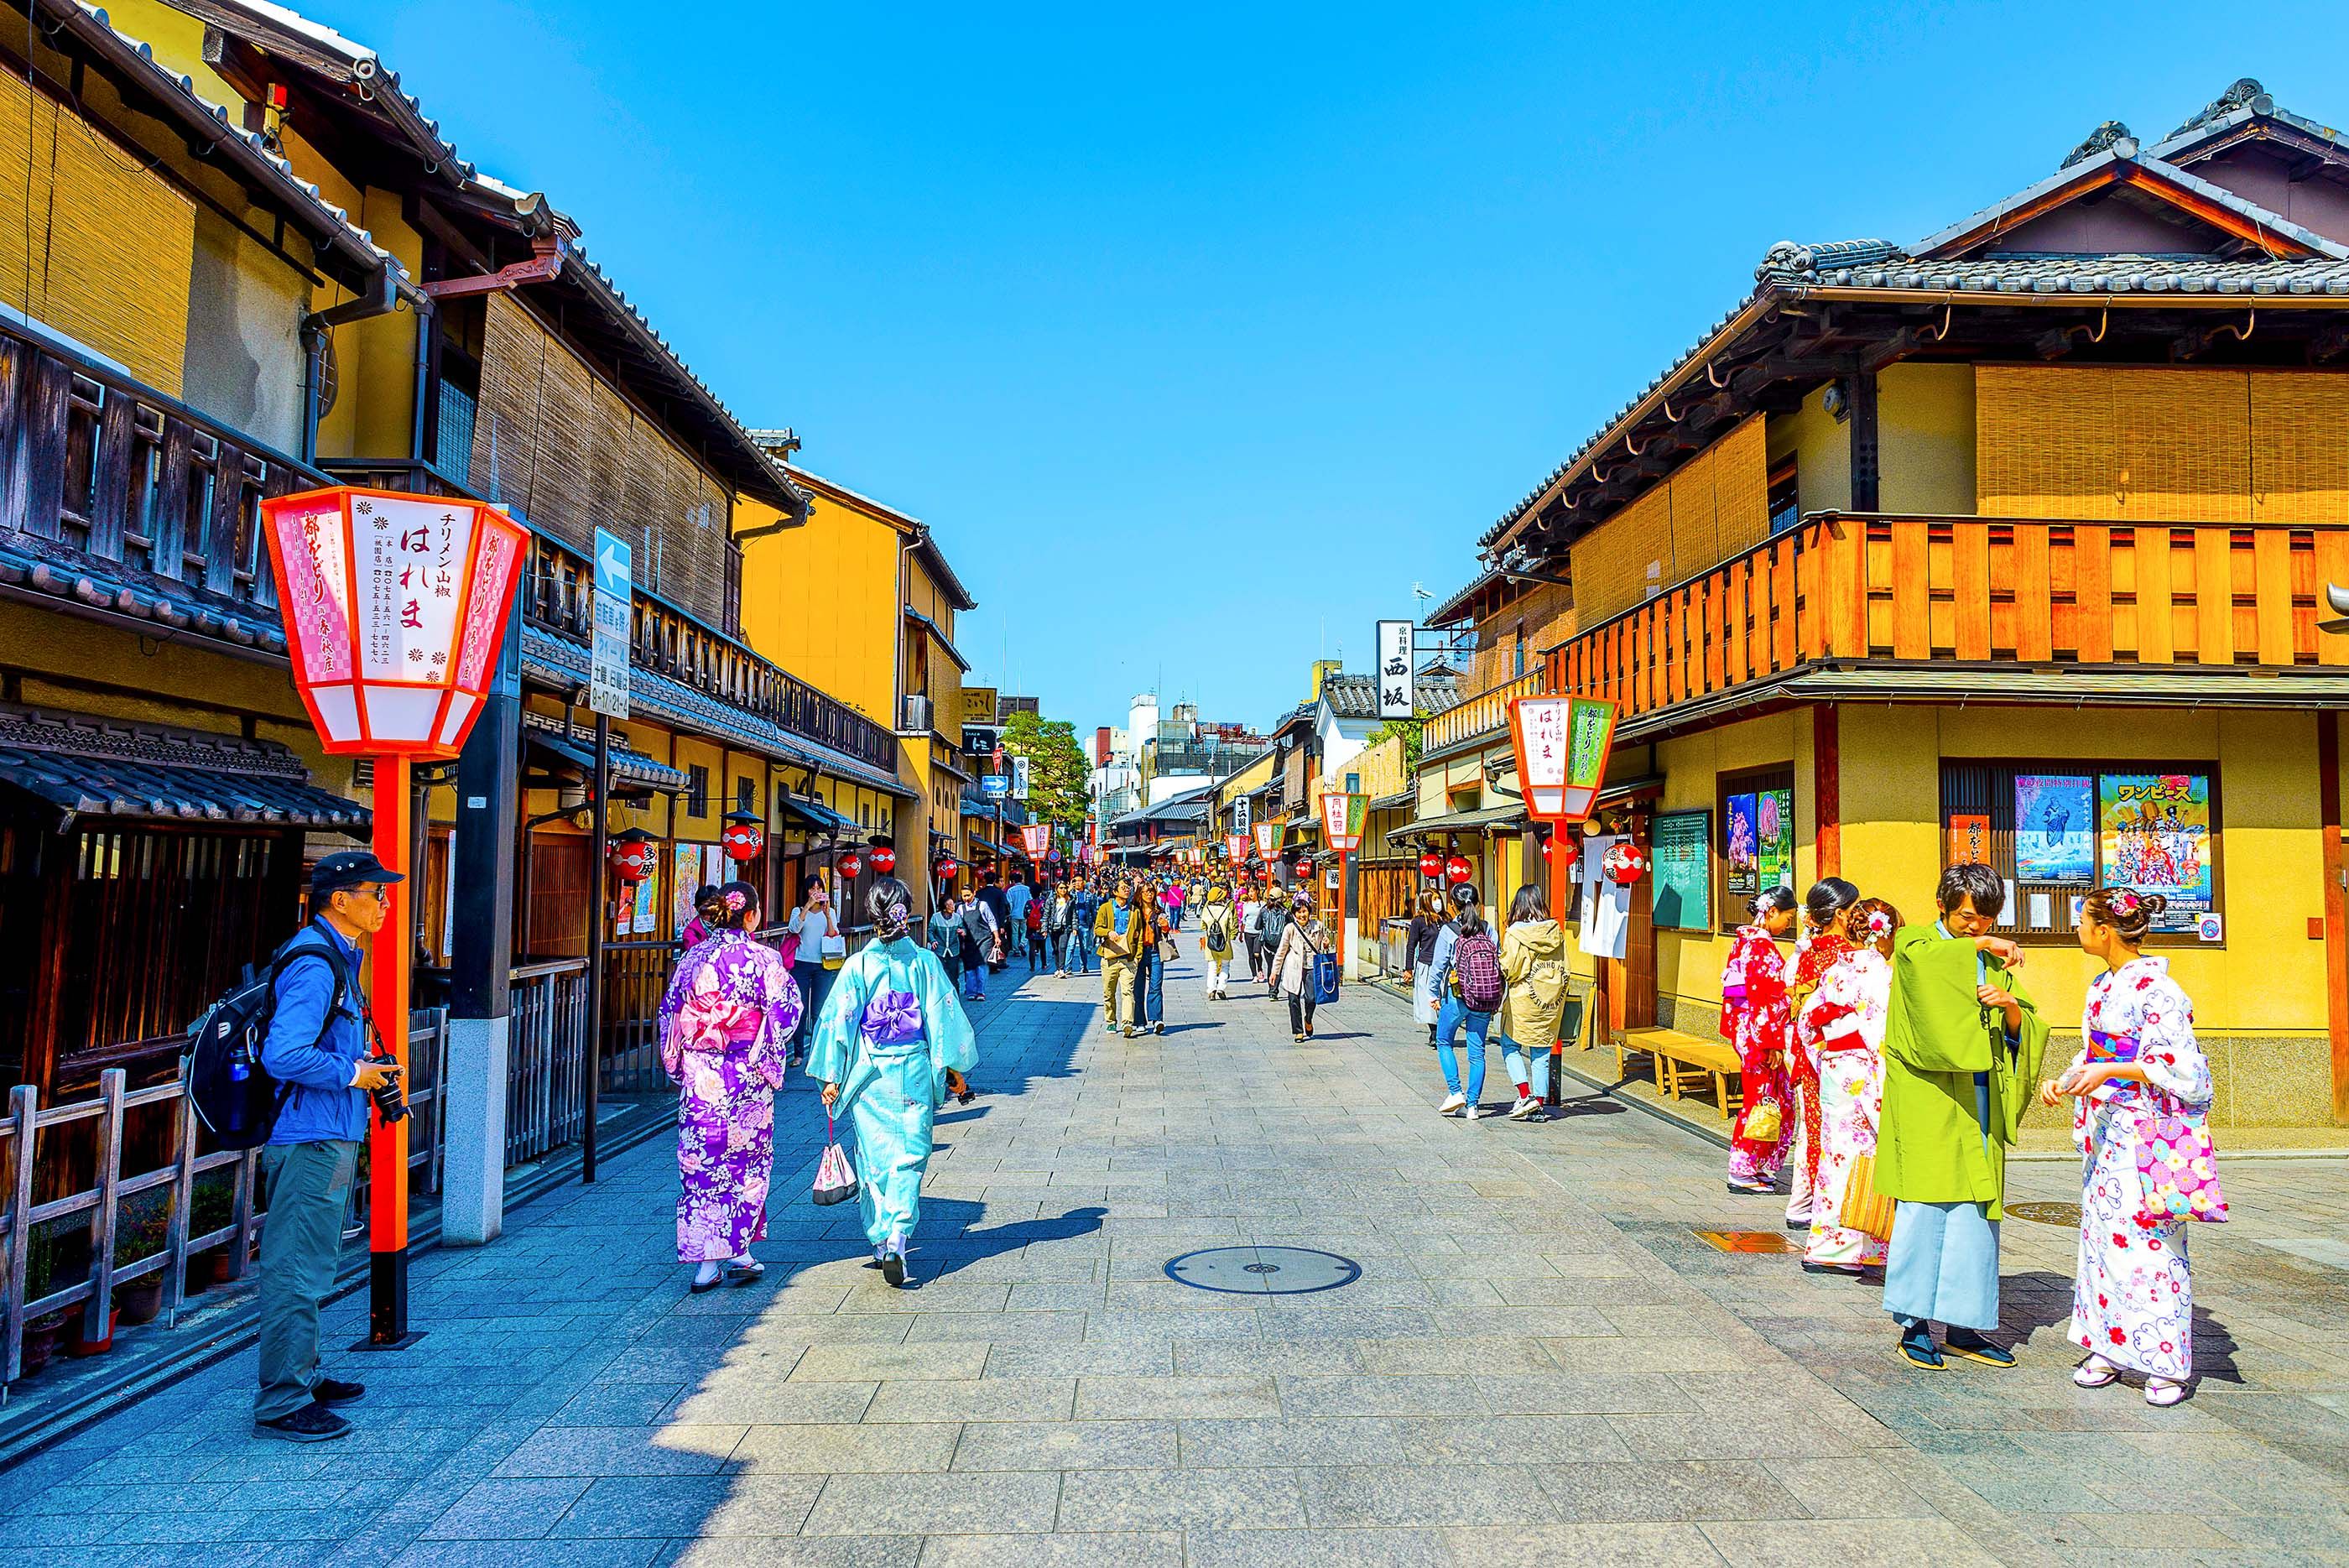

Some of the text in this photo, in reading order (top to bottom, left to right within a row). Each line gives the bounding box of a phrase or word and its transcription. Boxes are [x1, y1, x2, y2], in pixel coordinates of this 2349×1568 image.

[304, 513, 325, 604] 都をどり
[398, 524, 431, 629] はれま
[435, 513, 456, 598] チリメン山椒
[1398, 627, 1408, 655] 京料理
[1383, 656, 1410, 706] 西坂
[1540, 711, 1553, 759] はれま
[1584, 706, 1598, 749] 都をどり
[1331, 798, 1343, 831] 月桂冠
[2118, 782, 2193, 803] ワンピース
[1967, 820, 1982, 862] 都をど
